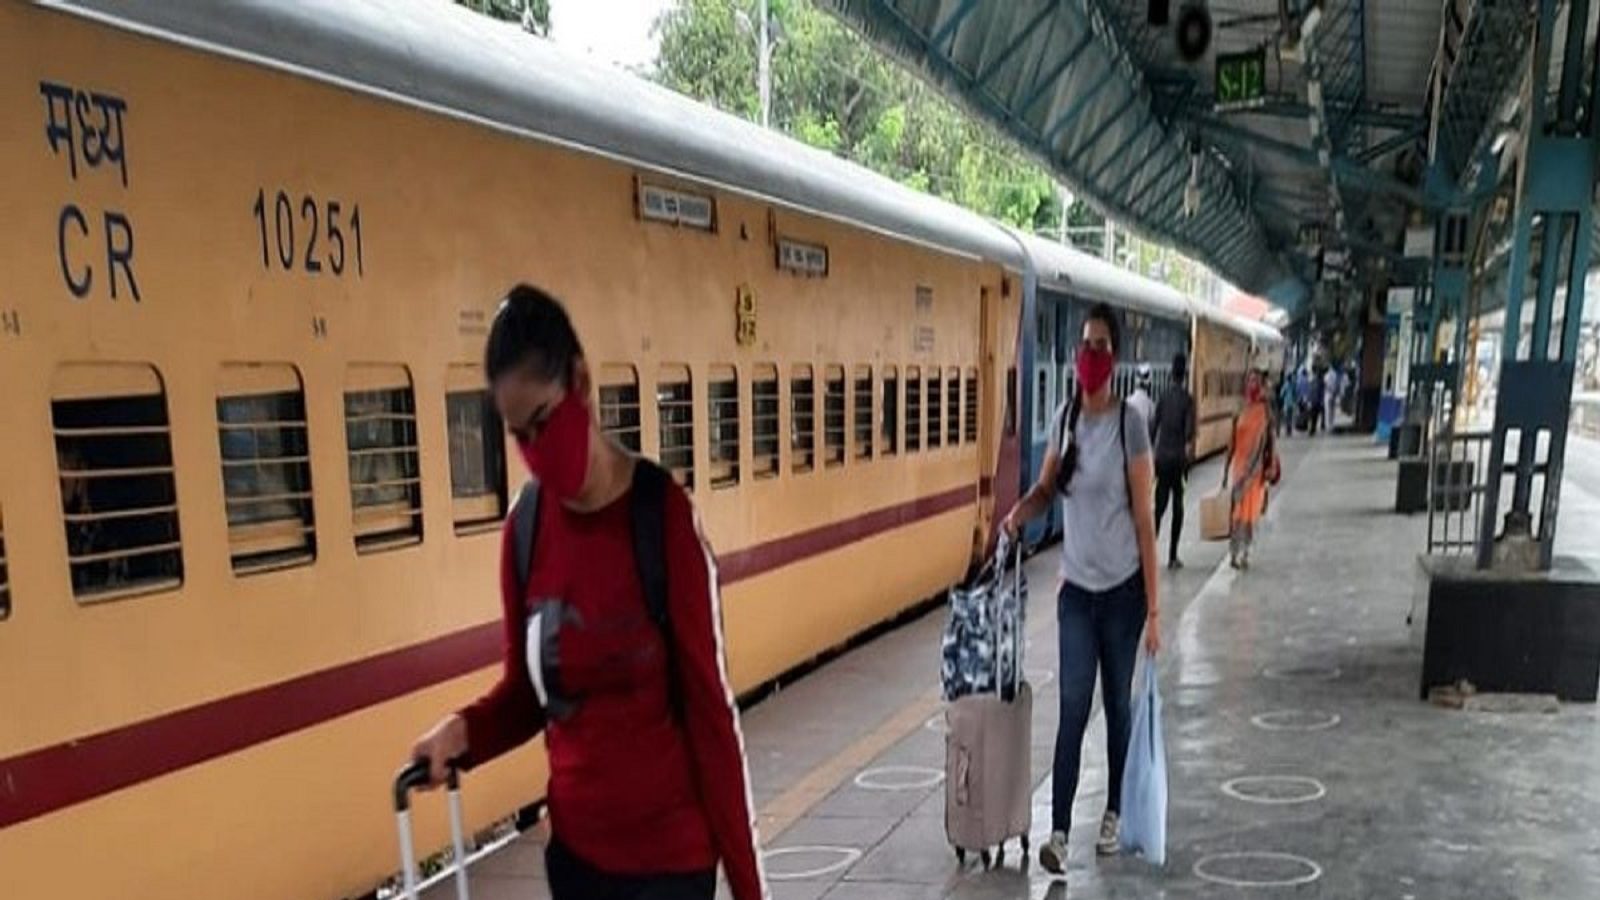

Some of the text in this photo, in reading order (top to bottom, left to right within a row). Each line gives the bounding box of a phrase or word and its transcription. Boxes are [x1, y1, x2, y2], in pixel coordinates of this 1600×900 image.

[1219, 61, 1261, 102] S-12
[38, 80, 129, 189] मध्य
[58, 204, 141, 303] CR
[253, 188, 363, 276] 10251
